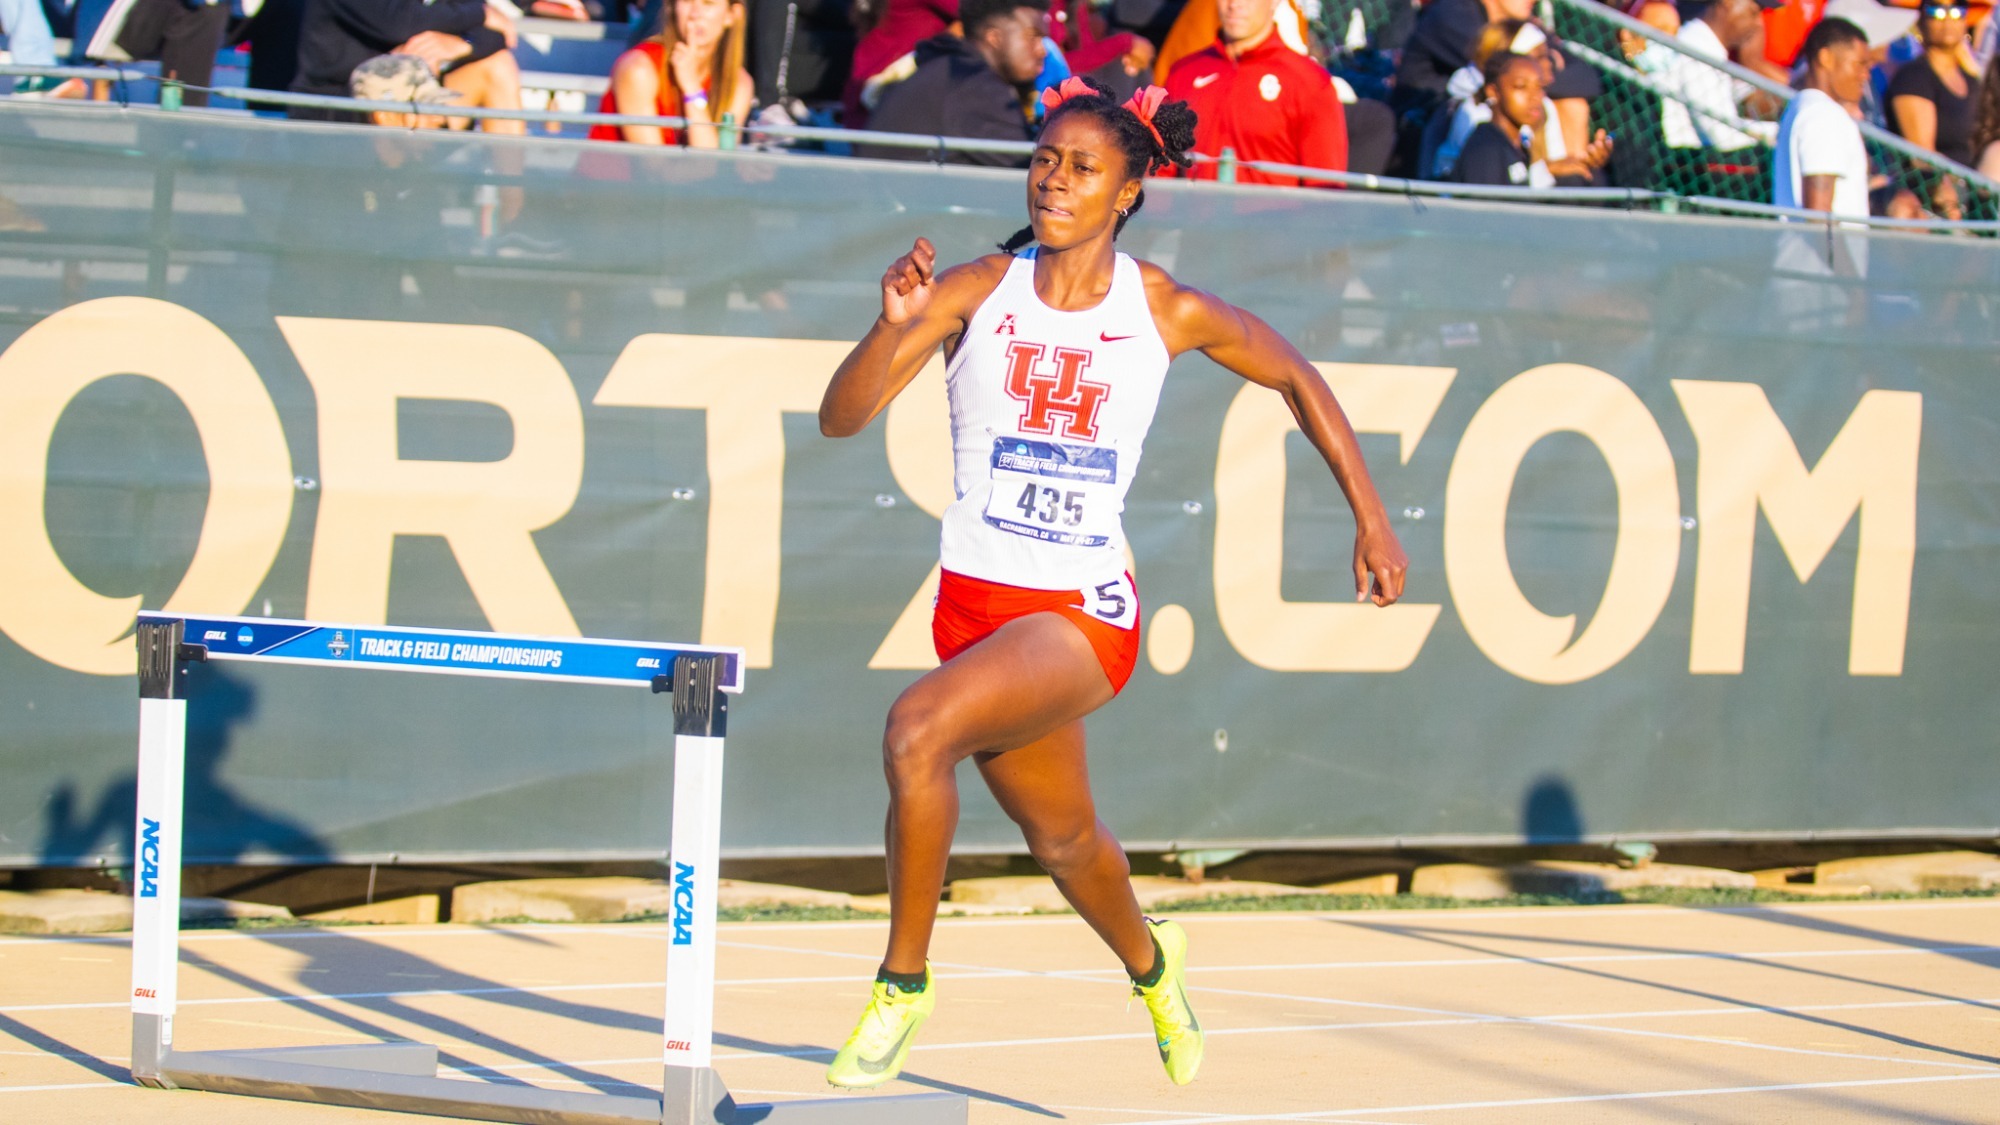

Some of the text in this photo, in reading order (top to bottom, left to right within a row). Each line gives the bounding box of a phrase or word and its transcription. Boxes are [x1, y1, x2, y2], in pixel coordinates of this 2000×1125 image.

[1004, 340, 1111, 443] UH
[1013, 458, 1035, 469] TRACK
[1039, 461, 1058, 471] FIELD
[1017, 482, 1086, 526] 435
[1040, 530, 1049, 540] CA
[1094, 580, 1126, 619] 5
[203, 630, 227, 641] GILL
[360, 637, 563, 668] TRACK & FIELD CHAMPIONSHIPS
[636, 657, 660, 668] GILL
[140, 817, 160, 898] NCAA
[672, 861, 695, 945] NCAA
[134, 987, 157, 999] GILL
[666, 1040, 691, 1051] GILL
